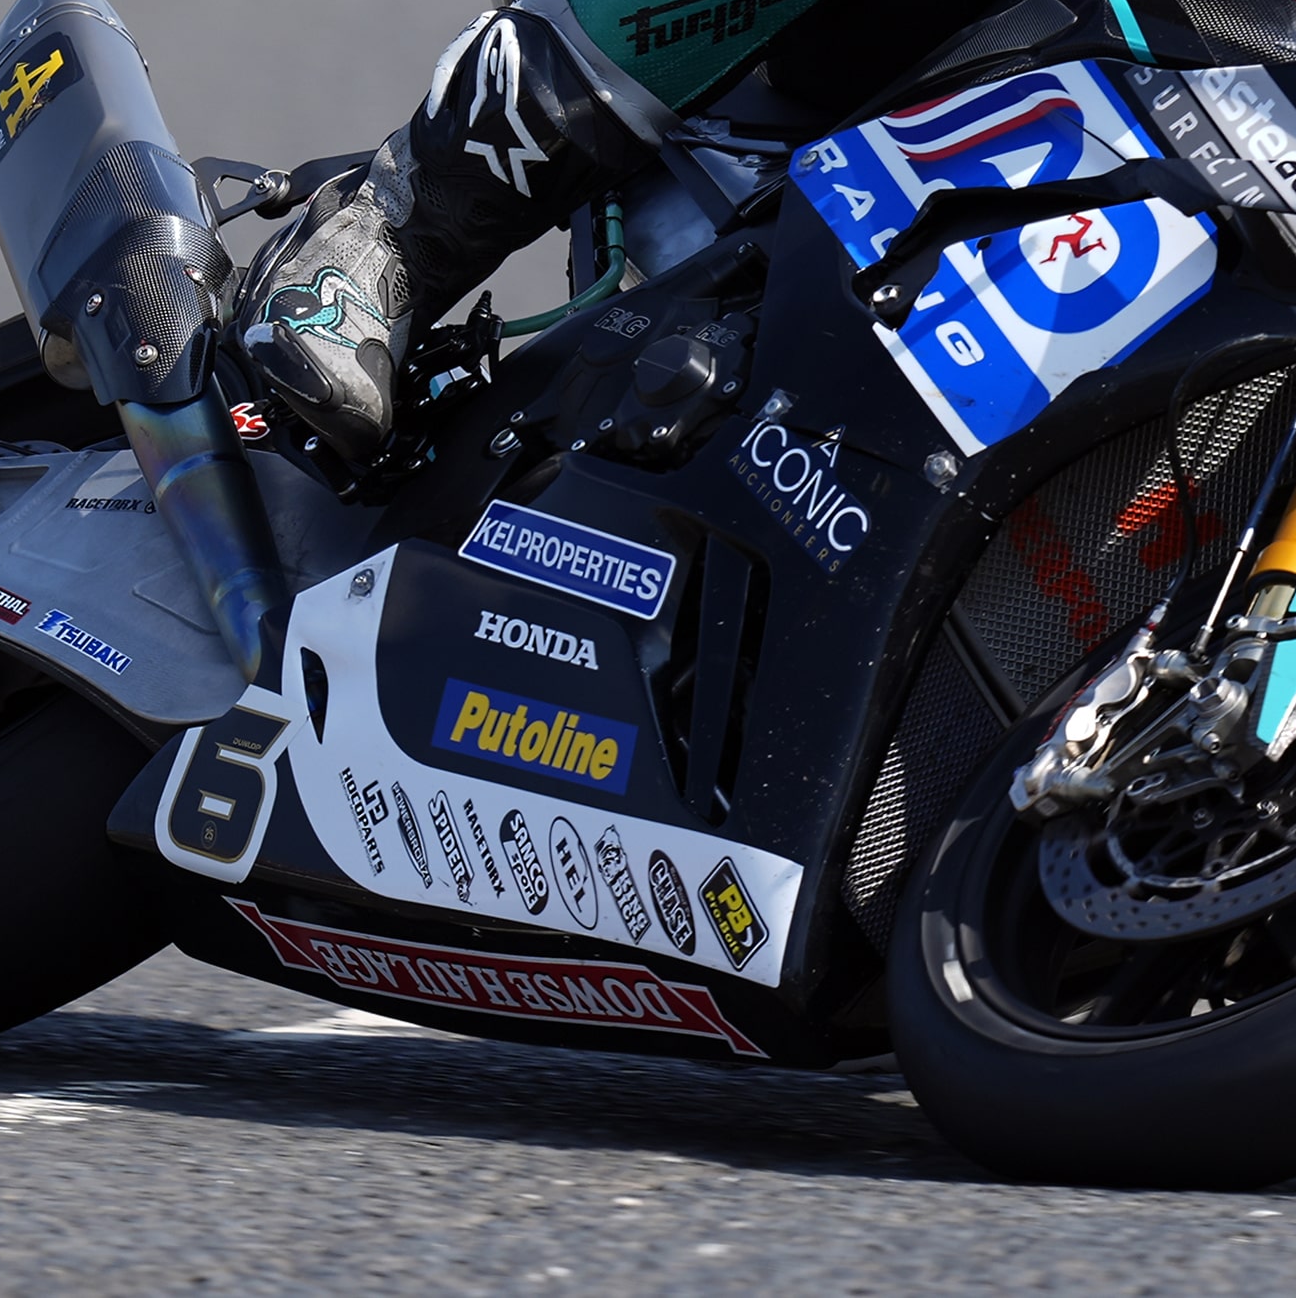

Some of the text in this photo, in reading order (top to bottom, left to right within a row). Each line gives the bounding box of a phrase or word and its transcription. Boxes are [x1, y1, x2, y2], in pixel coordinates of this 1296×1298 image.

[63, 496, 144, 513] RACETORX
[728, 453, 840, 572] AUCTIONEERS
[740, 422, 868, 553] ICONIC
[477, 515, 664, 602] KELPROPERTIES
[56, 620, 130, 675] TSUBAKI
[474, 610, 600, 671] HONDA
[232, 736, 262, 753] DUNLOP
[449, 690, 620, 781] Putoline
[166, 703, 290, 866] 6
[341, 767, 386, 874] HOCOPARTS
[391, 781, 433, 888] POWERBRONZE
[427, 790, 472, 886] SPIDER
[463, 799, 507, 900] RACETORX
[509, 813, 548, 899] SAMCO
[554, 836, 590, 913] HEL
[510, 854, 539, 908] sport
[608, 880, 643, 942] DICK
[615, 870, 649, 931] KING
[648, 858, 694, 950] CHASE
[705, 890, 741, 956] Pro-Bolt
[716, 883, 757, 936] PB
[309, 938, 681, 1023] DOWSE HAULAGE
